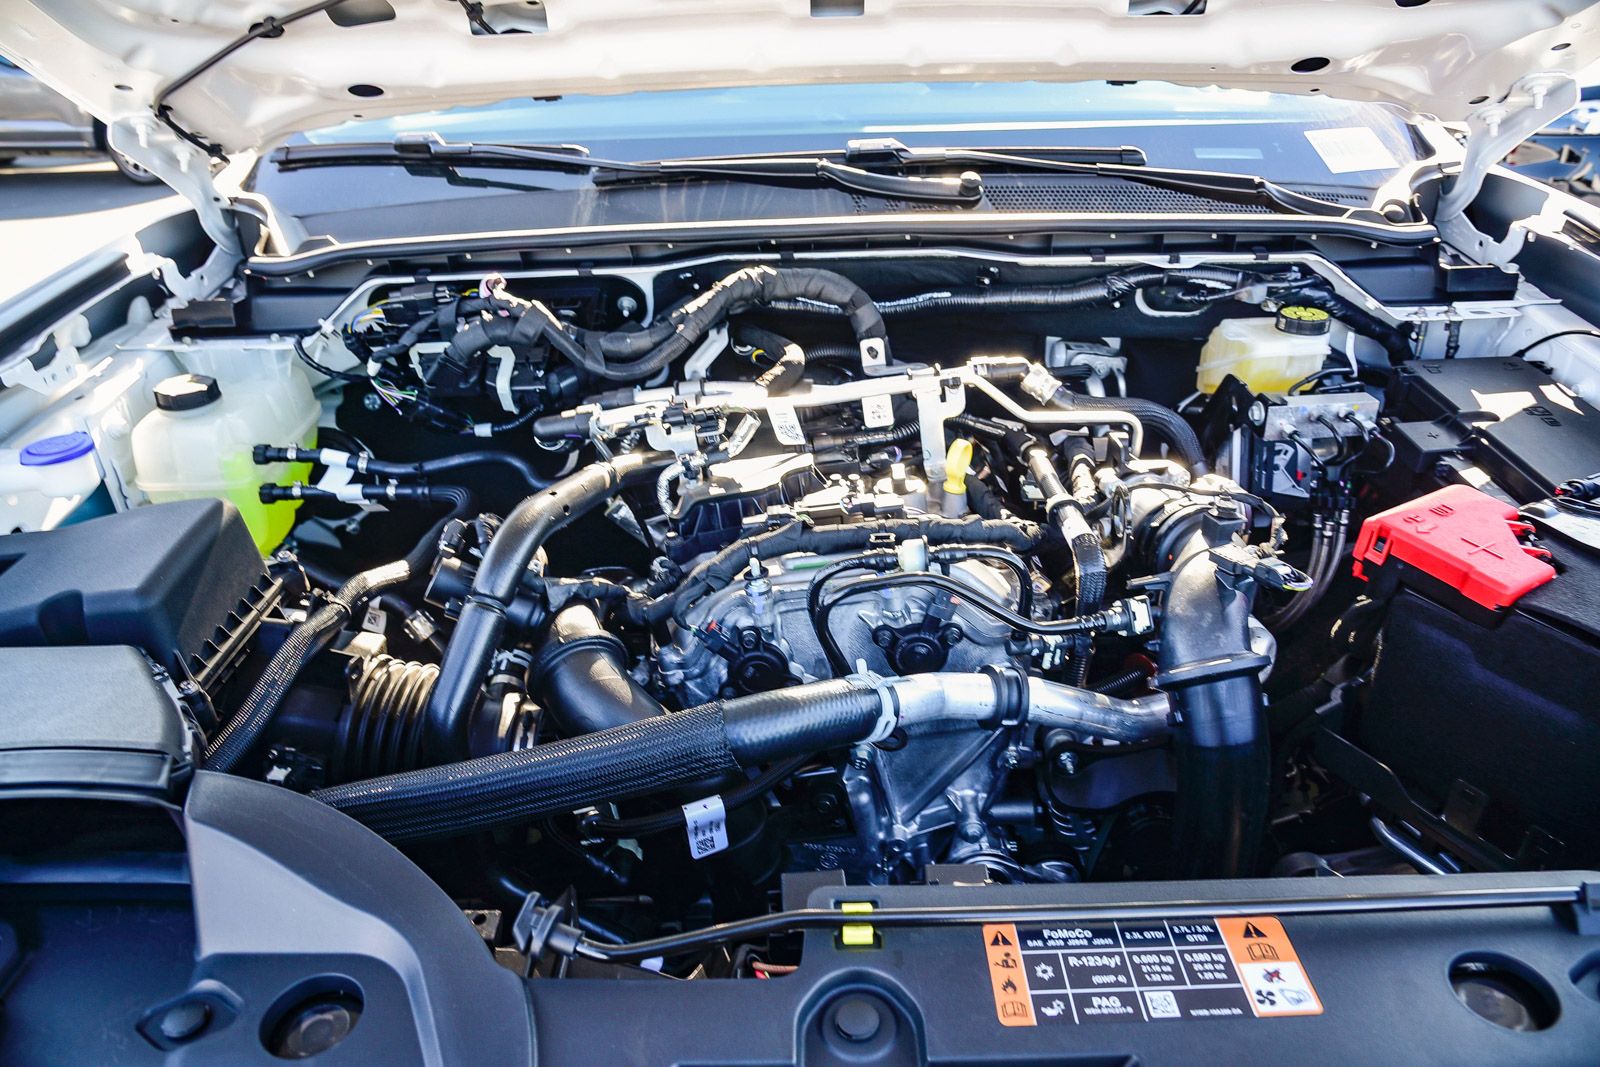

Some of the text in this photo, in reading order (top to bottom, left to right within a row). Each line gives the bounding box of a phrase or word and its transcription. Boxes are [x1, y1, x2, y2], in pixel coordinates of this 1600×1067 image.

[1044, 928, 1093, 939] FoMoCo
[1068, 954, 1121, 968] R-1234yf
[1092, 996, 1122, 1008] PAG
